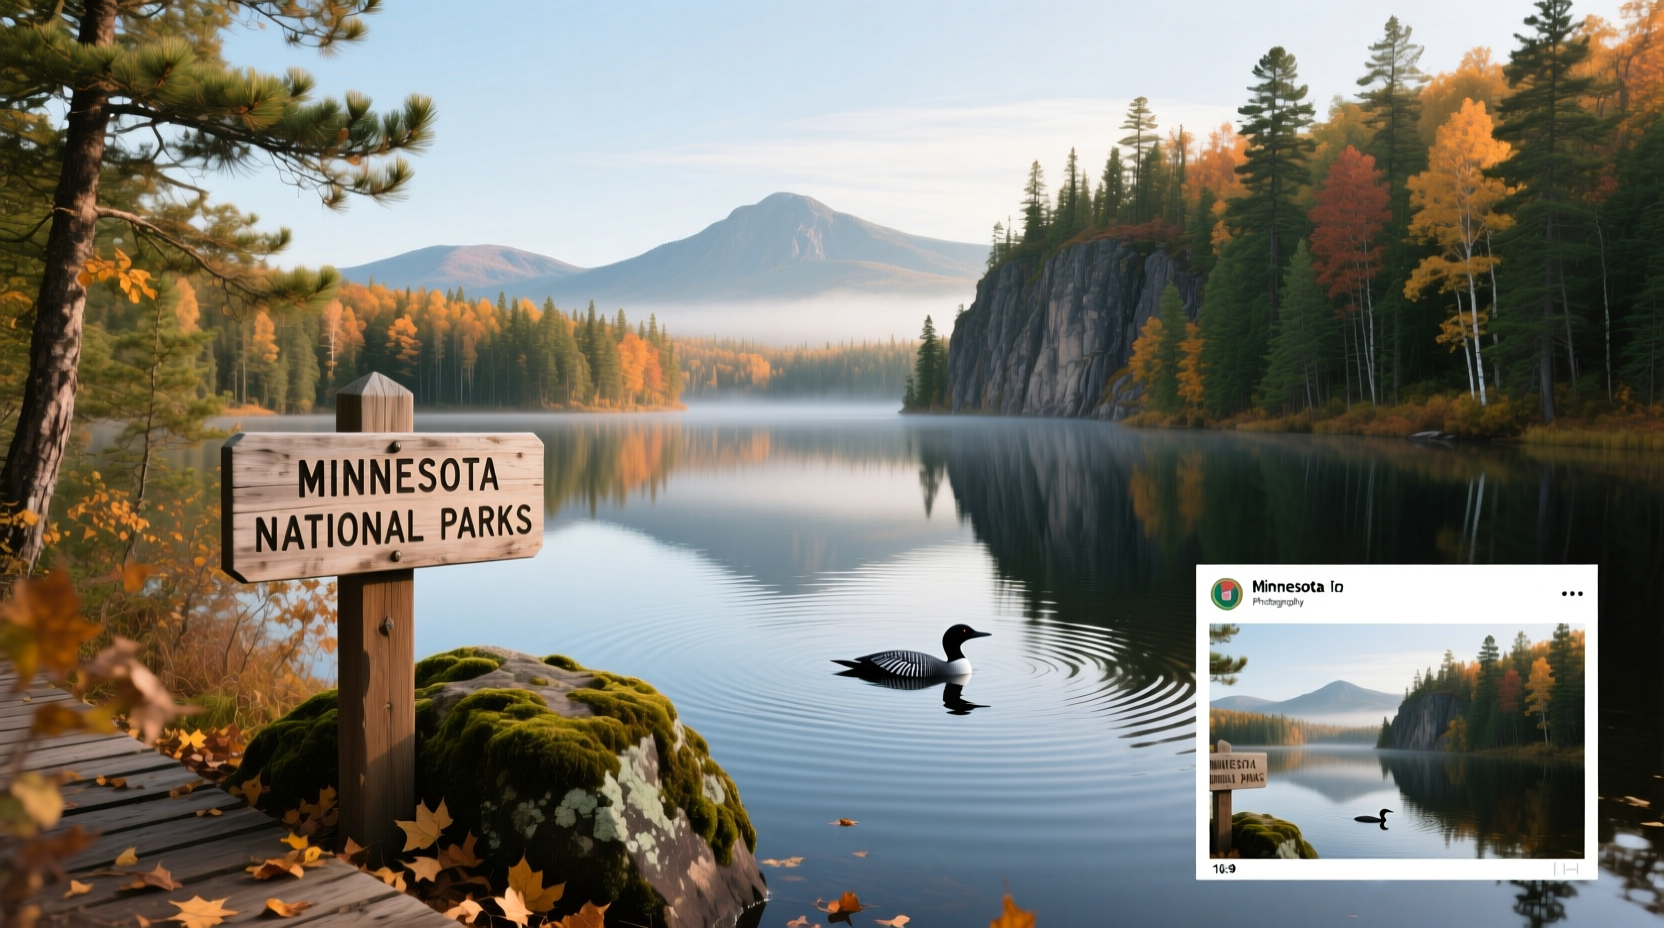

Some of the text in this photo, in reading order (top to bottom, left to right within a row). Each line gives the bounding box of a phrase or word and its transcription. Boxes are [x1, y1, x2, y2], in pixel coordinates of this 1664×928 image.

[298, 457, 499, 497] MINNESOTA
[255, 504, 532, 552] NATIONAL PARKS
